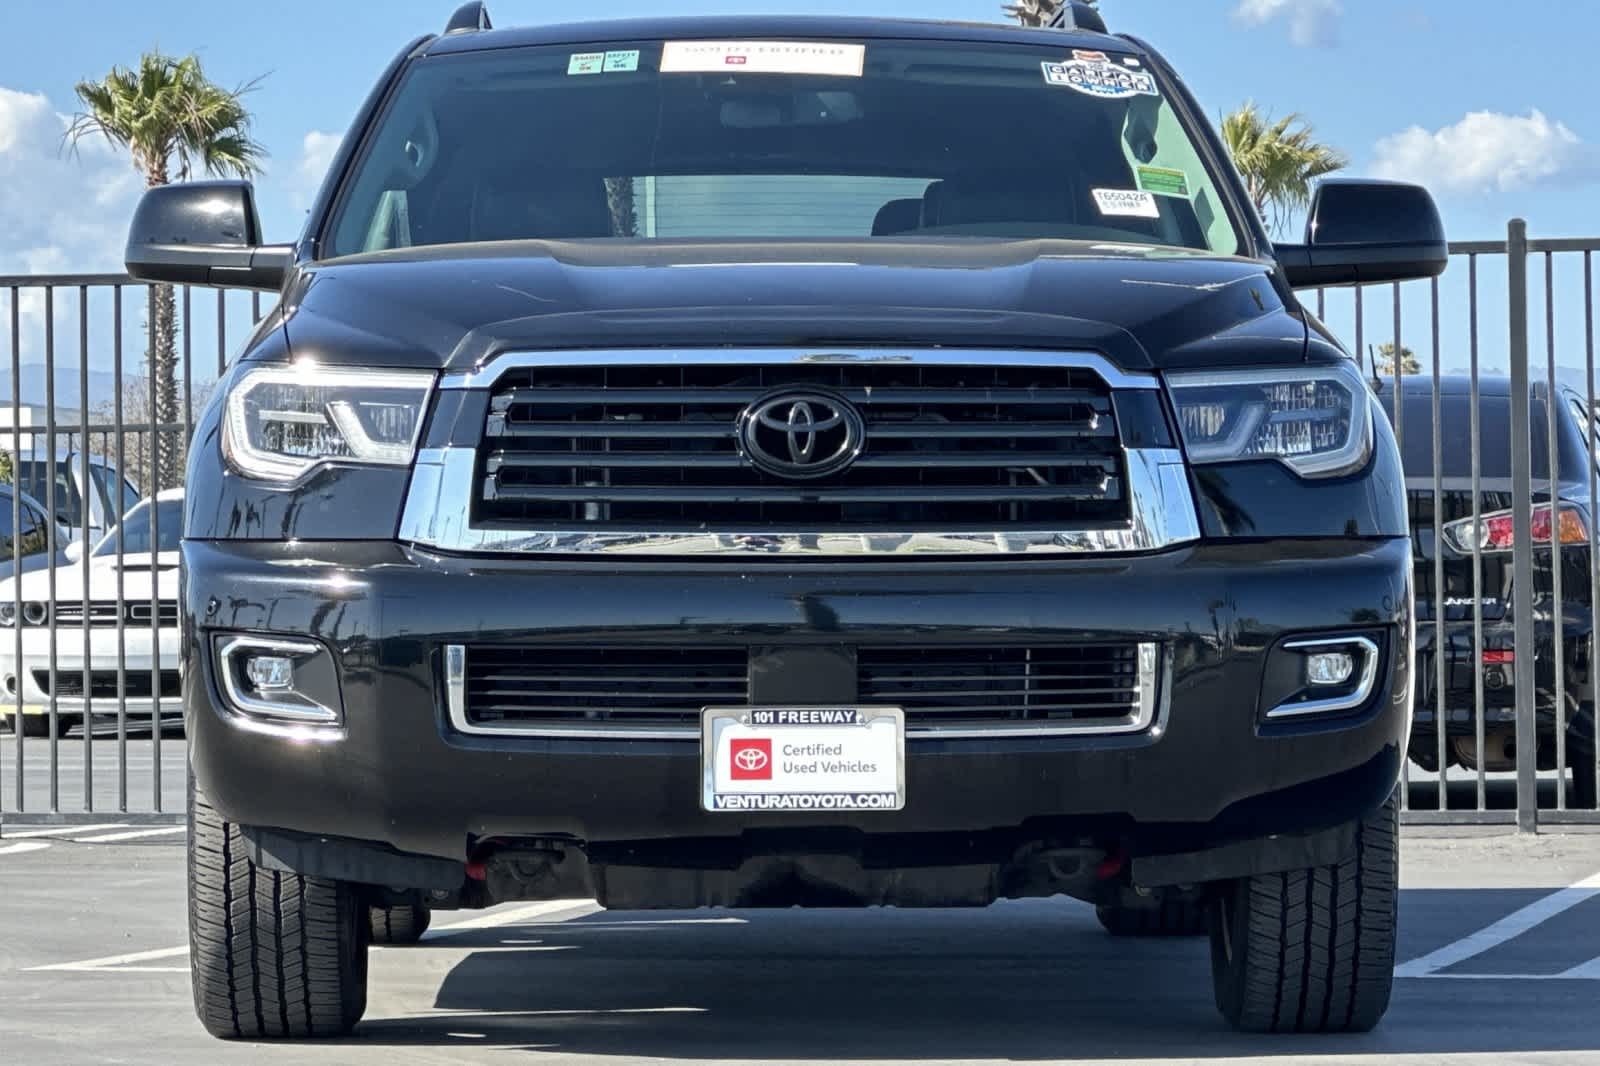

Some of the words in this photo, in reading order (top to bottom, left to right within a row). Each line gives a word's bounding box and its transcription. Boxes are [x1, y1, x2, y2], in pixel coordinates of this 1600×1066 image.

[753, 711, 775, 724] 101
[778, 710, 855, 724] FREEWAY
[782, 744, 843, 757] Certified
[782, 762, 818, 774] Used
[821, 761, 878, 774] Vehicles
[715, 794, 896, 809] VENTURATOYOTA.COM
